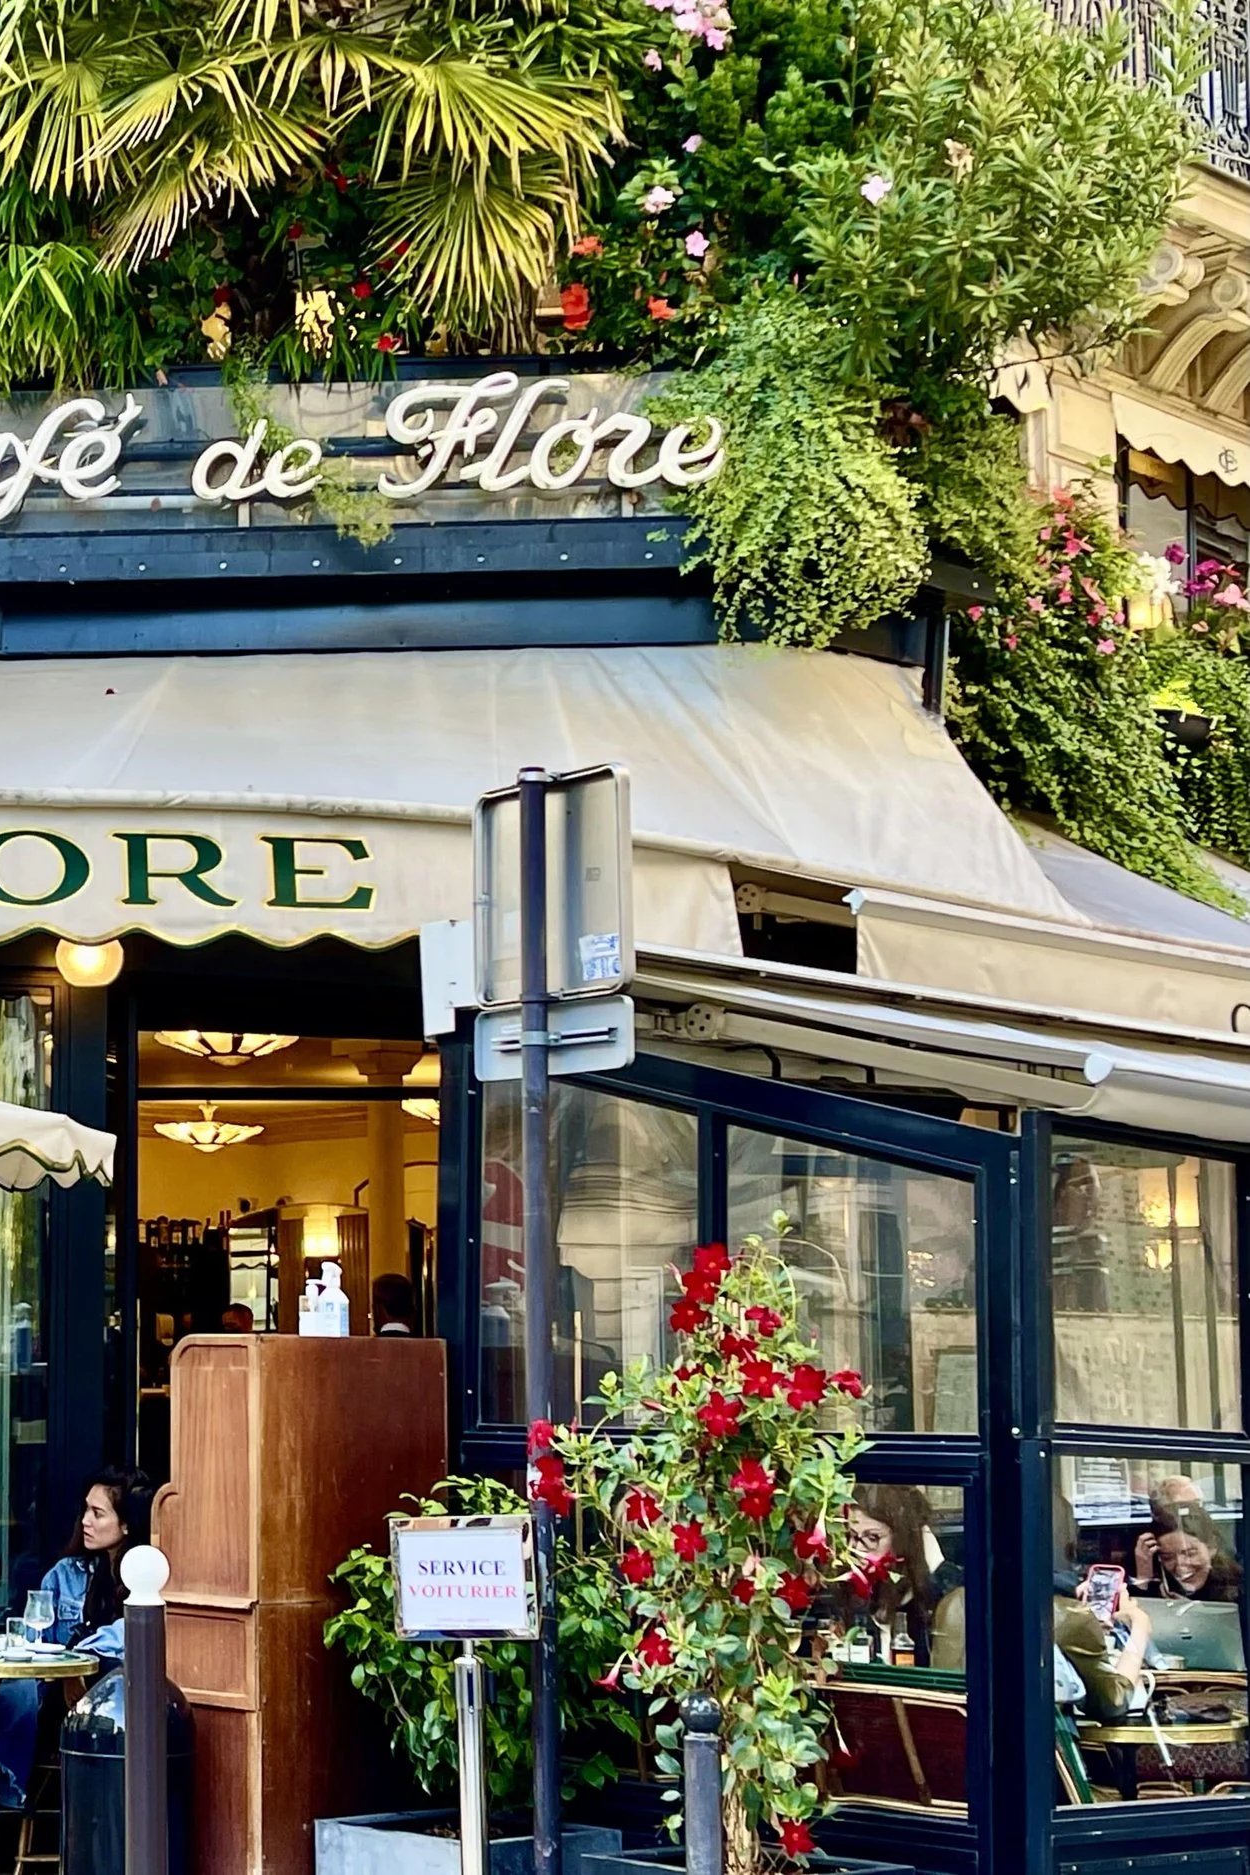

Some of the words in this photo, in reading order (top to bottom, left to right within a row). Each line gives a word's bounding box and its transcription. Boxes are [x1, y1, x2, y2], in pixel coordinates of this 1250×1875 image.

[190, 418, 324, 501] de
[377, 371, 726, 499] Flore
[418, 1560, 506, 1576] SERVICE
[408, 1584, 517, 1598] VOITURIER
